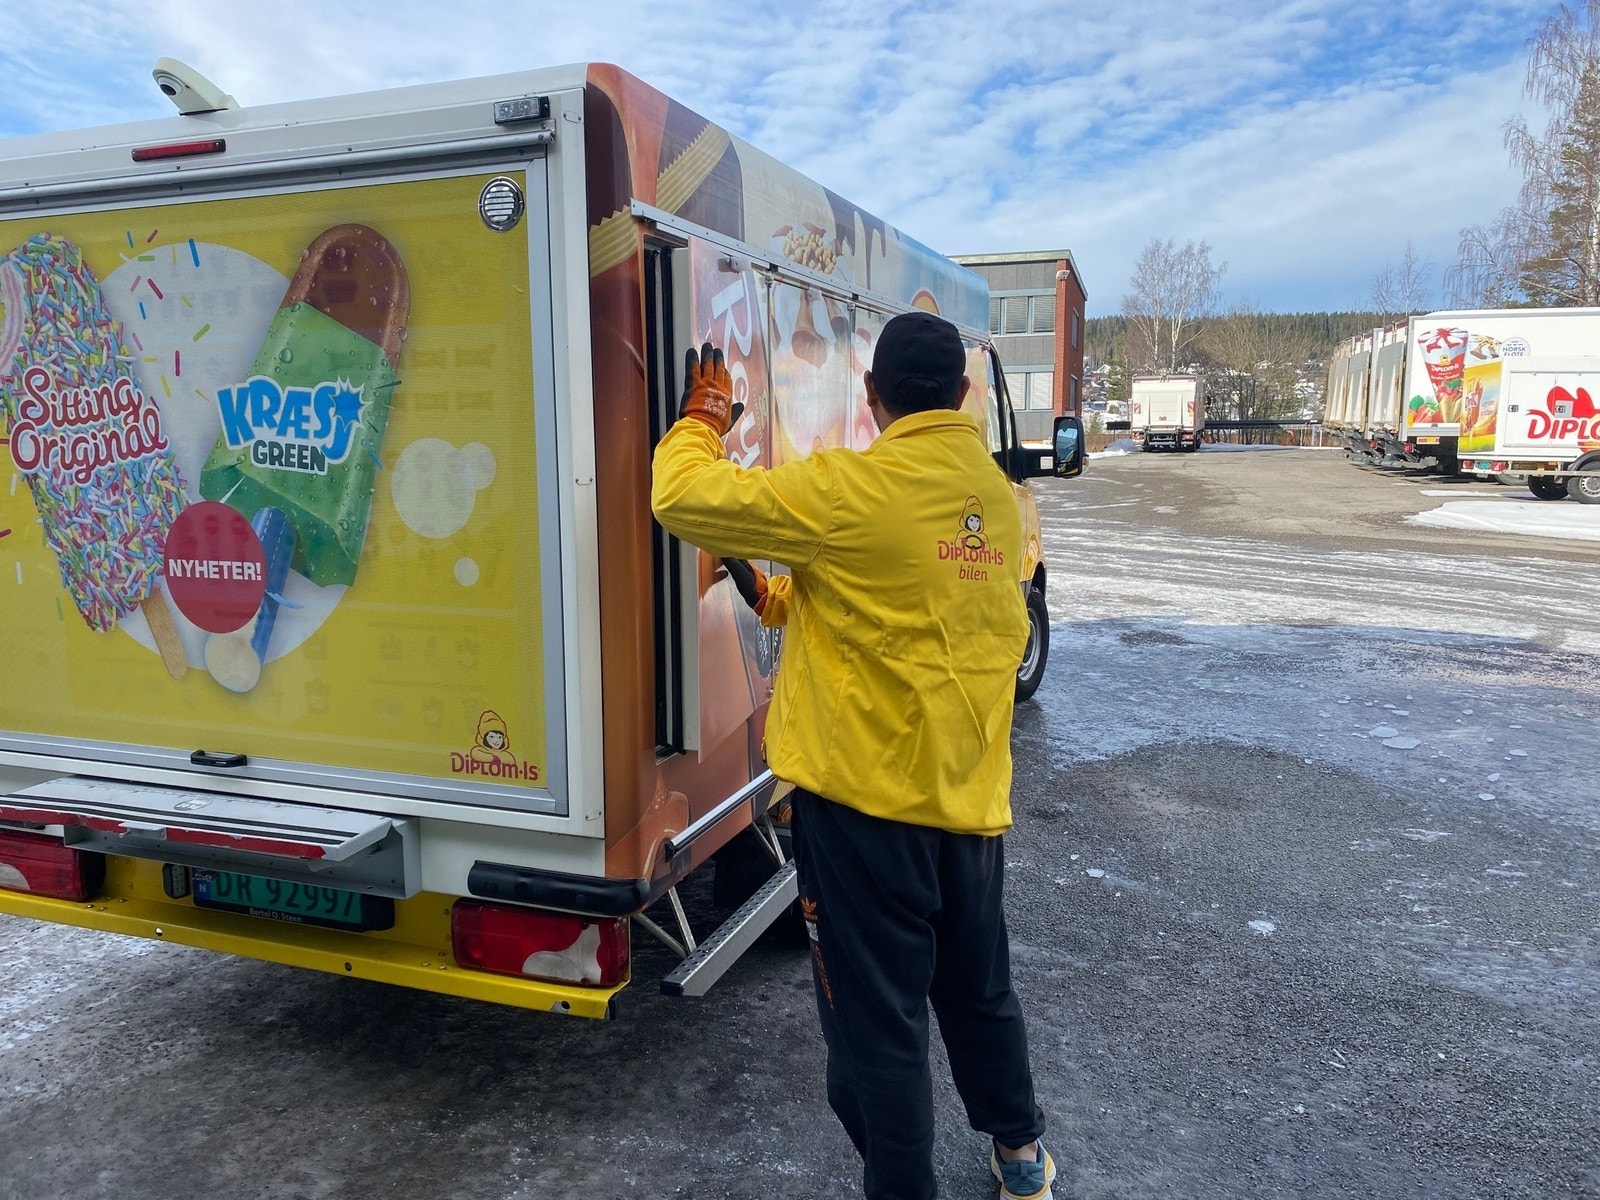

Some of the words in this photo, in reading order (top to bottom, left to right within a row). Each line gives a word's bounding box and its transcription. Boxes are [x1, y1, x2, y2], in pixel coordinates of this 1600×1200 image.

[20, 366, 142, 427] Sitting
[11, 407, 168, 484] Original
[252, 439, 326, 472] GREEN
[168, 558, 262, 580] NYHETER!
[958, 564, 988, 581] bilen
[216, 871, 251, 901] DR
[282, 912, 302, 923] Steen
